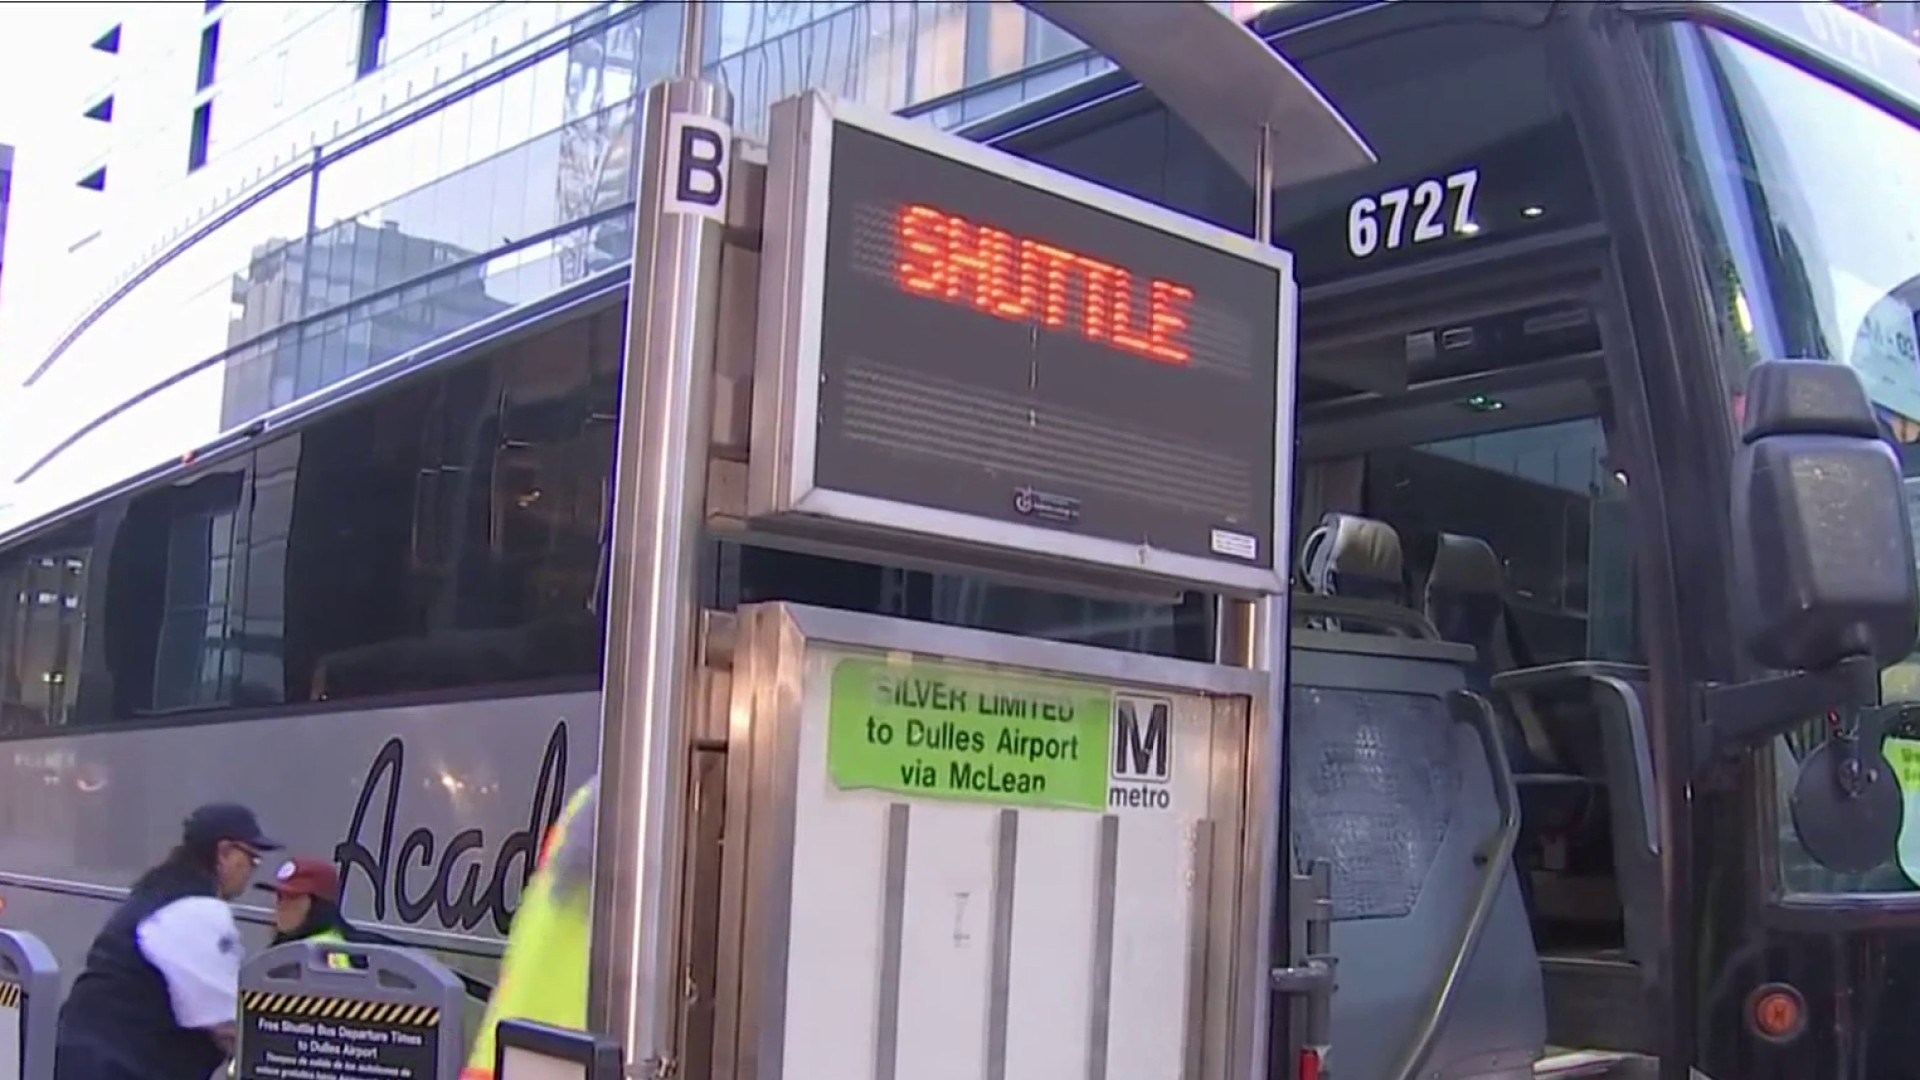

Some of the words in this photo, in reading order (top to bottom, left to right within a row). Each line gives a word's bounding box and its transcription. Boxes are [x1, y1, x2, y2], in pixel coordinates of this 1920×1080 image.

[676, 125, 724, 206] B
[1349, 169, 1478, 258] 6727
[897, 203, 1195, 368] SHUTTLE
[978, 692, 1075, 723] LIMITED
[866, 715, 894, 746] to
[906, 719, 985, 752] Dulles
[996, 727, 1079, 763] Airport
[1116, 701, 1168, 777] M
[900, 759, 936, 788] via
[949, 762, 1046, 794] McLean
[1108, 786, 1171, 810] metro
[334, 719, 568, 936] Acad
[257, 1016, 279, 1033] Free
[281, 1019, 315, 1037] Shuttle
[316, 1021, 337, 1038] Bus
[338, 1025, 389, 1043] Departure
[390, 1029, 422, 1046] Times
[297, 1040, 308, 1053] to
[309, 1040, 341, 1055] Dulles
[342, 1042, 378, 1060] Airport
